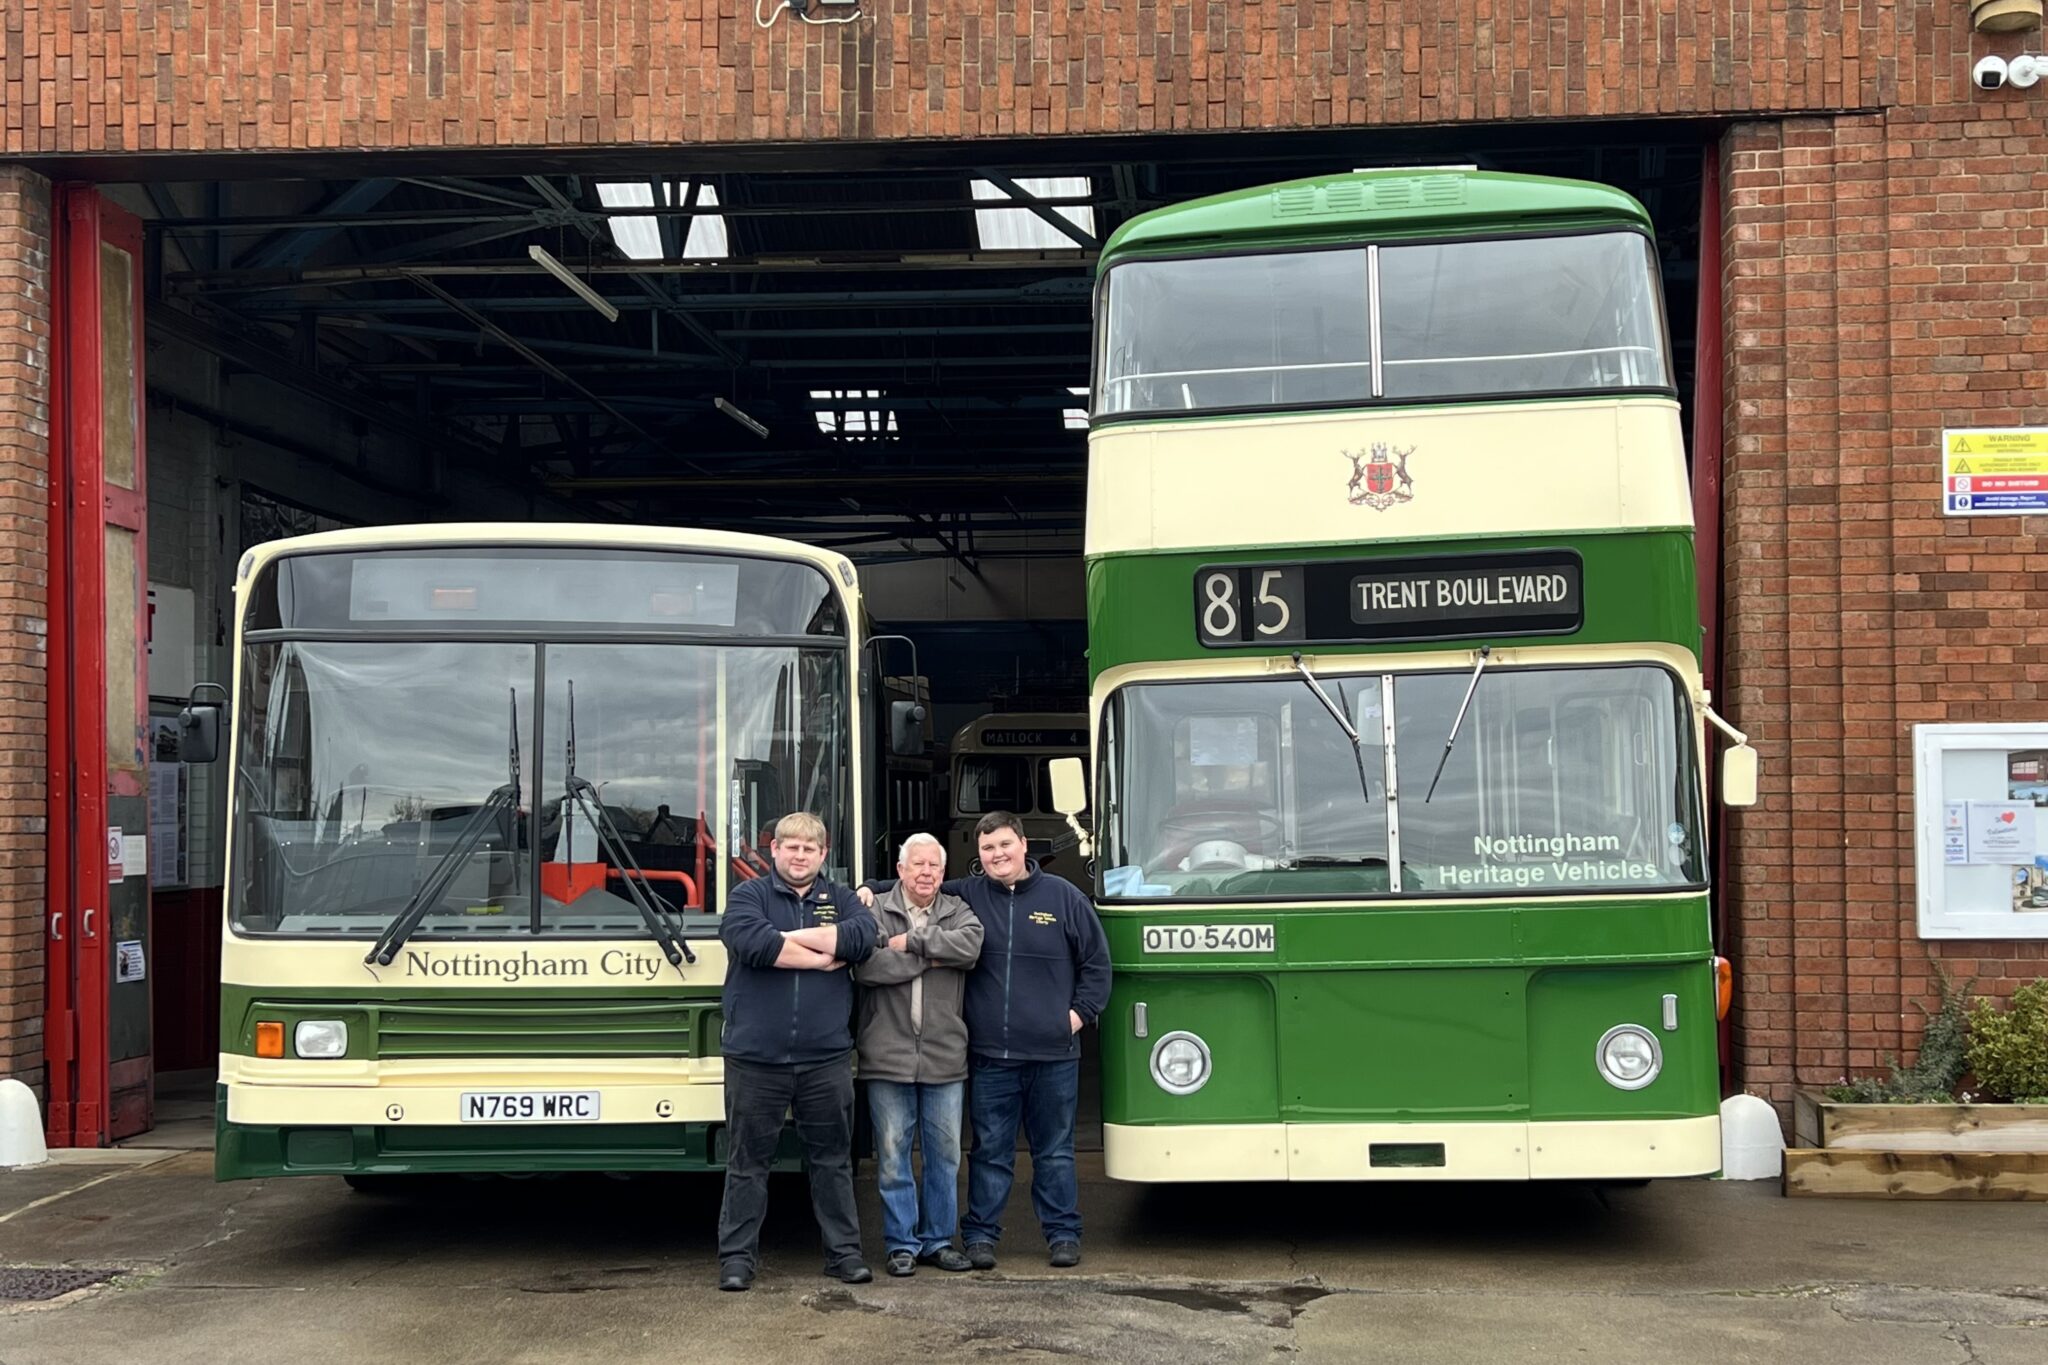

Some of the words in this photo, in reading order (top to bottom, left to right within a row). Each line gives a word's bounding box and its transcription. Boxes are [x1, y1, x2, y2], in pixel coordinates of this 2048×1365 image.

[1357, 579, 1431, 610] TRENT
[1436, 574, 1568, 606] BOULEVARD
[986, 731, 1043, 744] MATLOCK
[1070, 732, 1078, 744] 4
[1474, 833, 1620, 857] Nottingham
[1439, 864, 1545, 887] Heritage
[1552, 860, 1658, 881] Vehicles
[1146, 928, 1196, 950] OTO
[1204, 927, 1272, 949] 540M
[406, 951, 588, 982] Nottingham
[600, 950, 662, 981] City
[470, 1095, 534, 1118] N769
[543, 1095, 590, 1117] WRC
